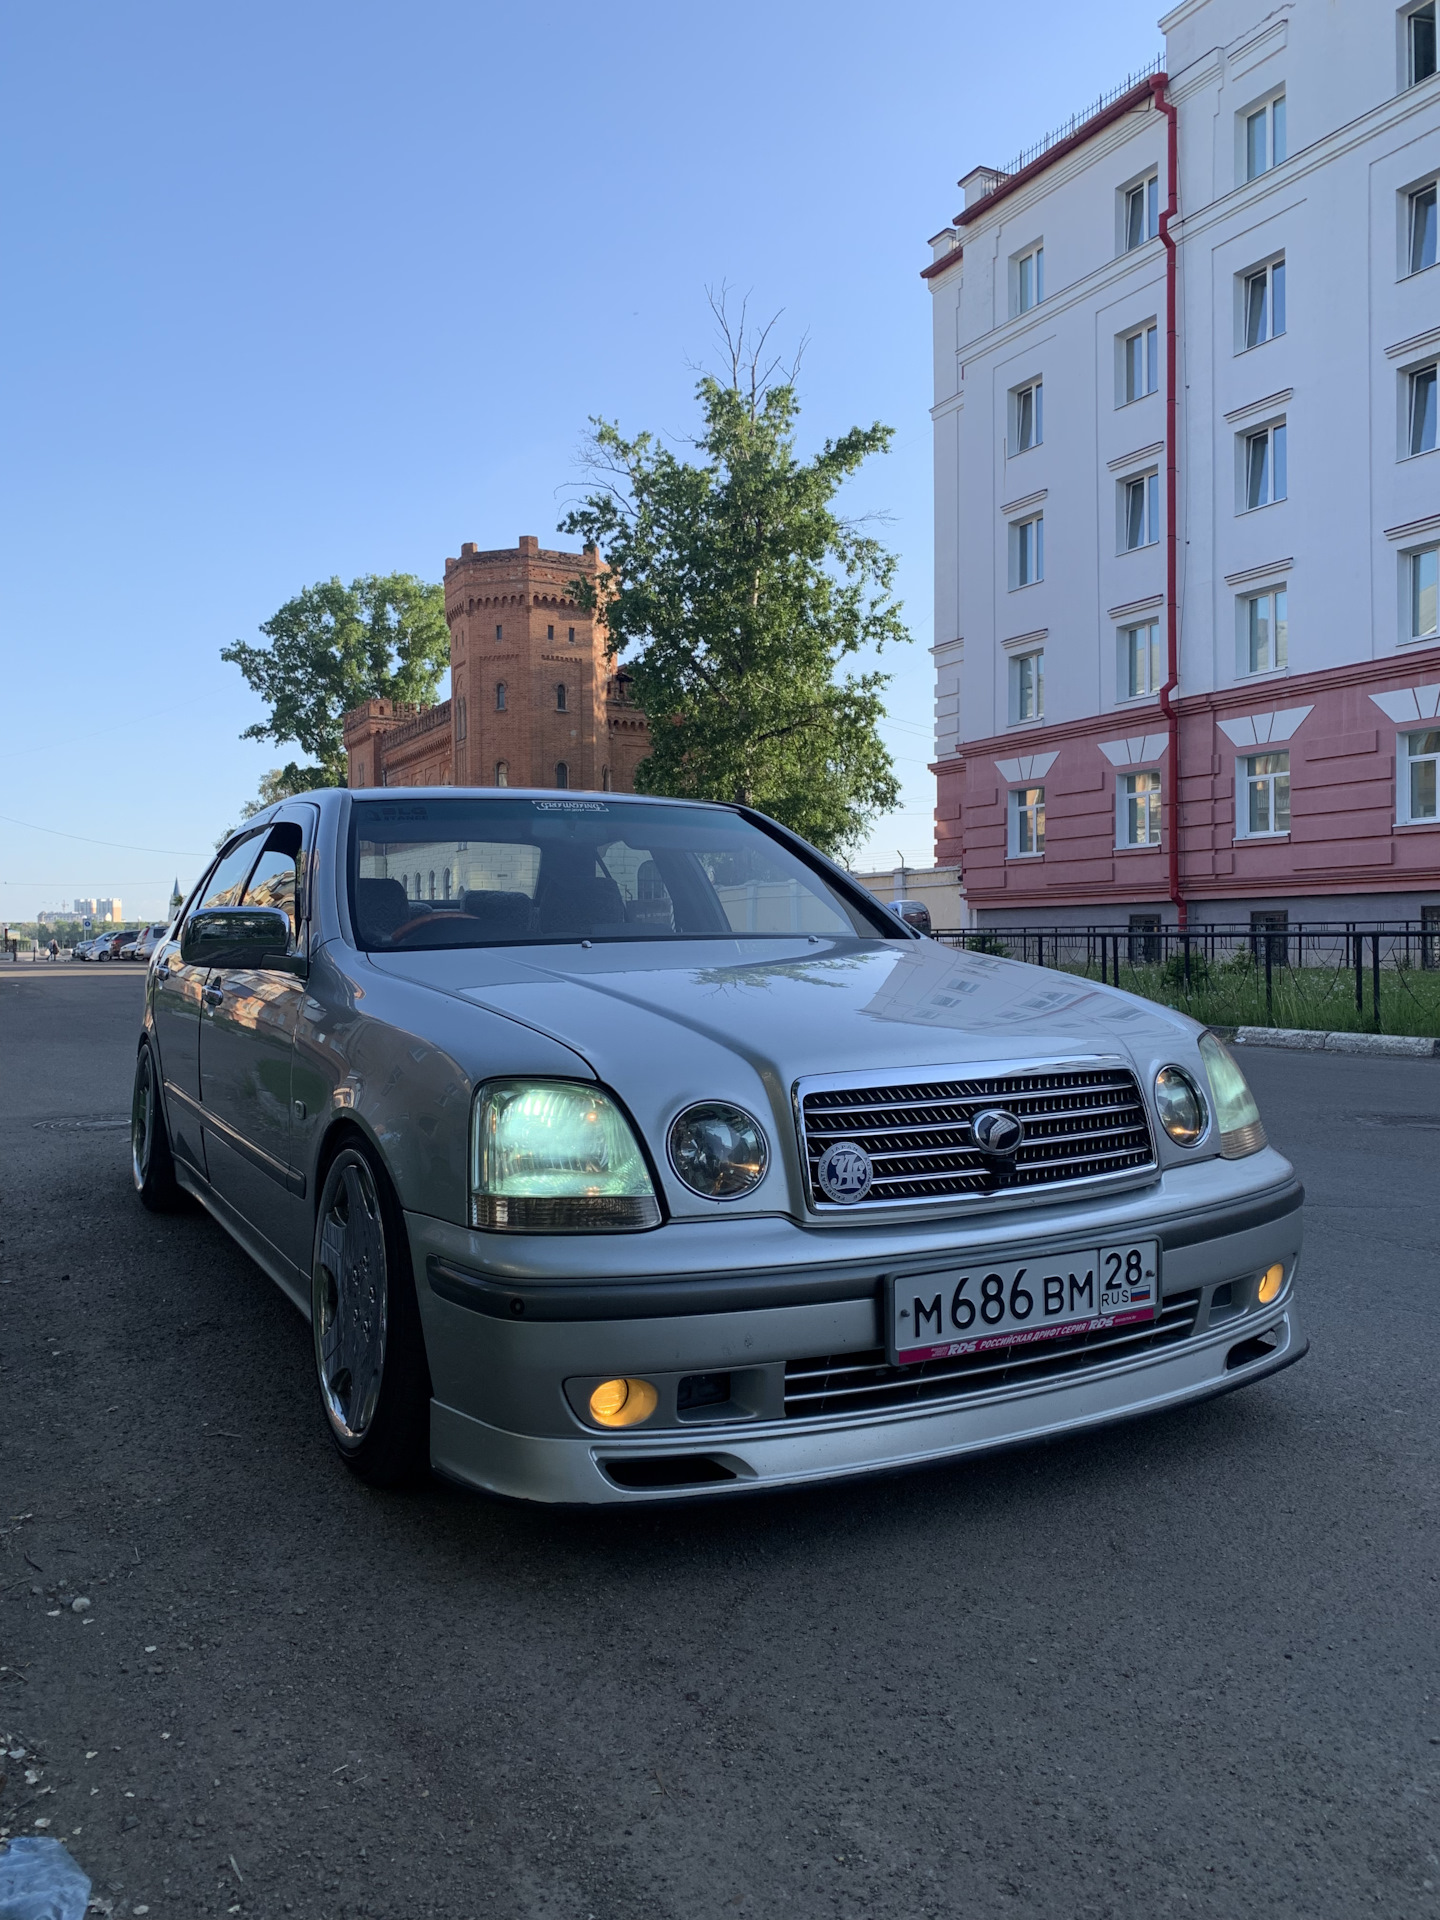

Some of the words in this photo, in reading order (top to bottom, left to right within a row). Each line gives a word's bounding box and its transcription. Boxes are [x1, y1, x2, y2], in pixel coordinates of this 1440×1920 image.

[831, 1144, 858, 1154] JAPAN
[820, 1159, 846, 1201] FEDERATION
[1105, 1249, 1143, 1291] 28
[1101, 1289, 1130, 1307] RUS
[947, 1340, 979, 1356] RDS
[980, 1332, 1033, 1350] РОССИЙСКАЯ
[1032, 1327, 1062, 1343] ДРИФТ
[1061, 1321, 1087, 1335] СЕРИЯ
[1088, 1315, 1117, 1331] RDS
